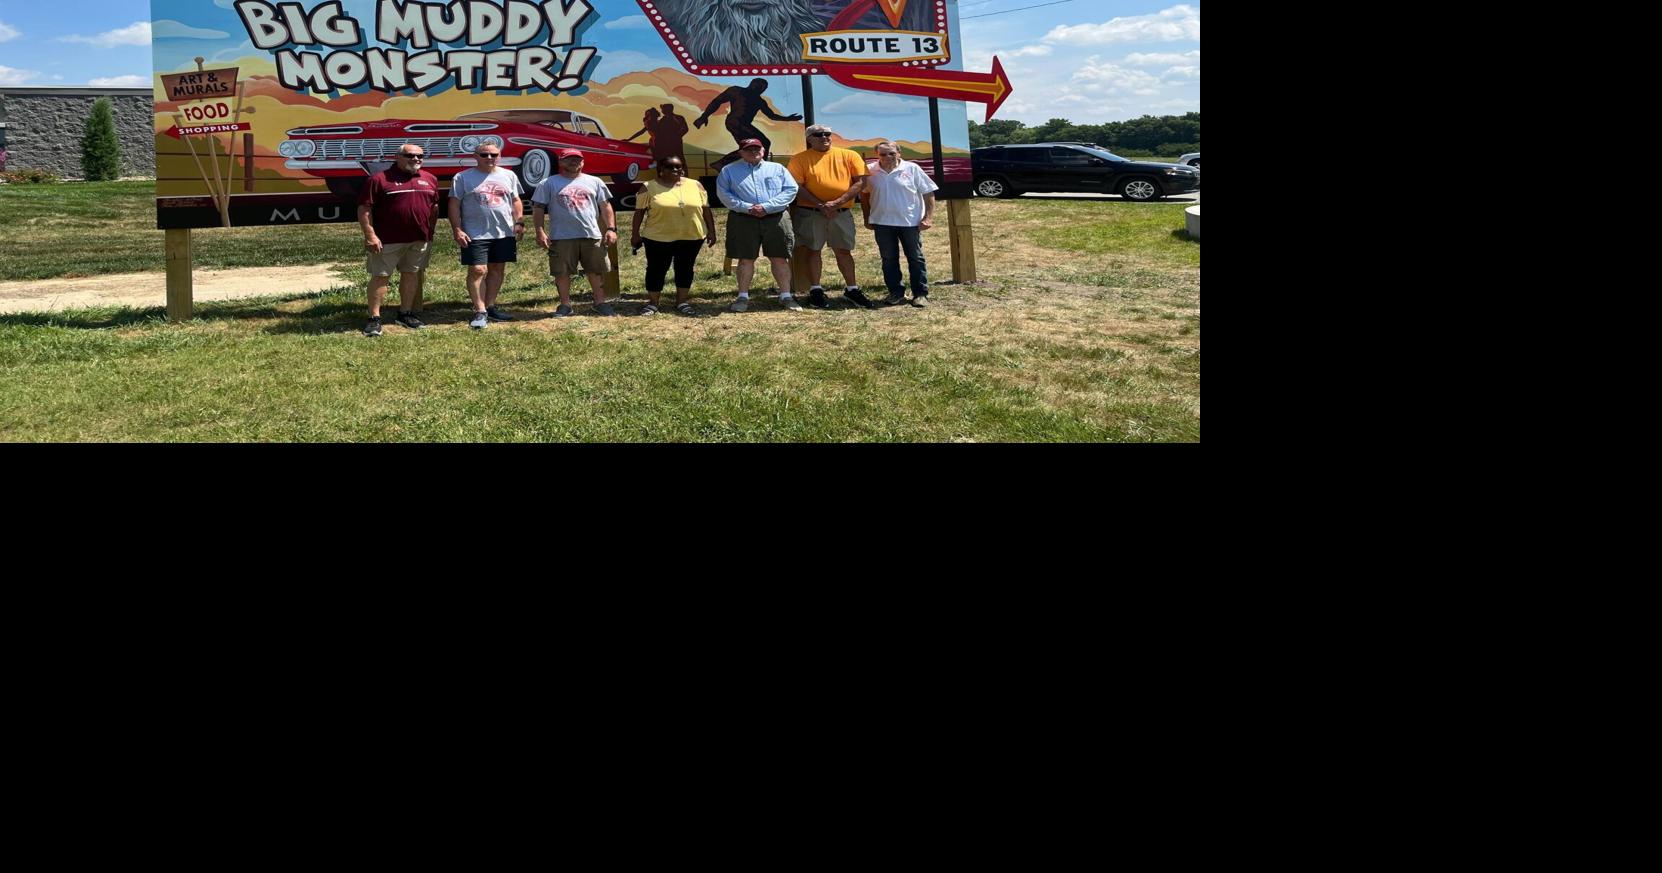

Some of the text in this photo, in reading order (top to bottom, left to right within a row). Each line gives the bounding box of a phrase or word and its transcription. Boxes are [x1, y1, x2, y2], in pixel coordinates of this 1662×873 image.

[235, 0, 594, 49] BIG MUDDY
[809, 37, 939, 54] ROUTE 13
[276, 47, 597, 93] MONSTER!
[178, 72, 218, 86] ART &
[173, 82, 229, 97] MURALS
[183, 102, 229, 121] FOOD
[178, 124, 239, 135] SHOPPING
